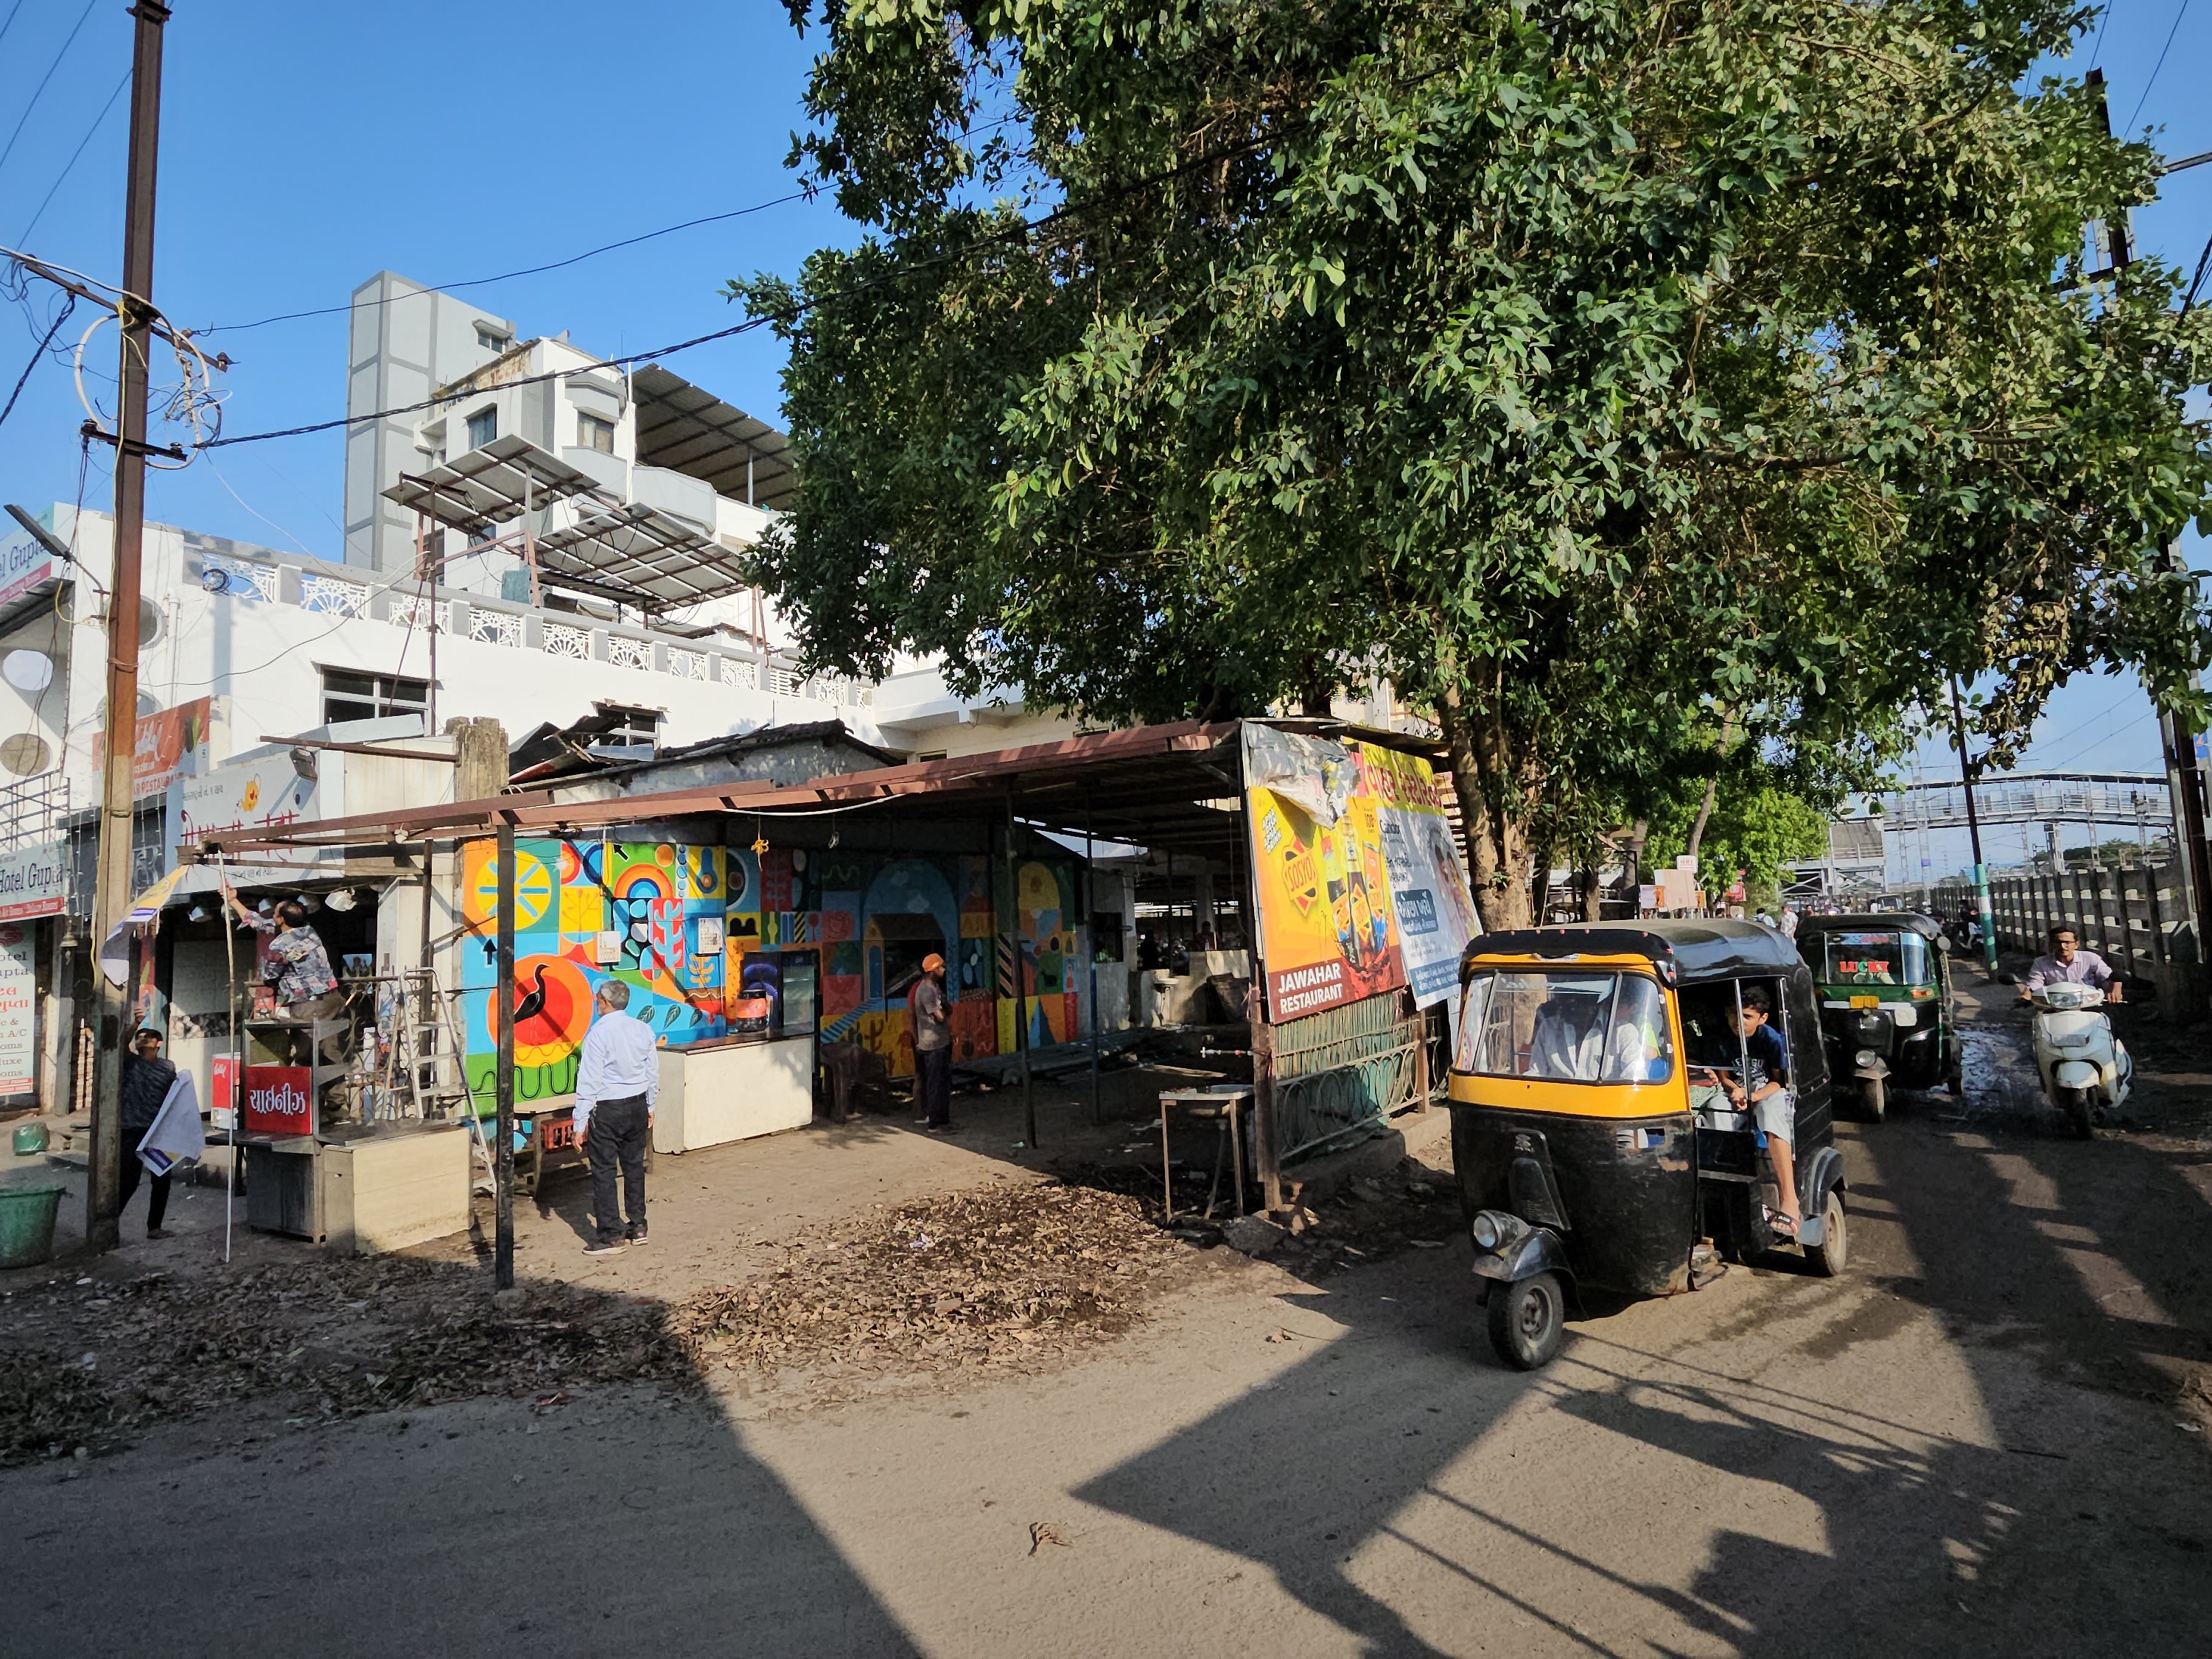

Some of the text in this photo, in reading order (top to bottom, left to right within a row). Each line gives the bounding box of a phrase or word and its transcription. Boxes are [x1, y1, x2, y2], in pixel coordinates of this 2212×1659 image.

[1287, 855, 1312, 892] SOSYO
[0, 950, 29, 961] otel
[0, 967, 29, 979] pta
[1839, 961, 1889, 973] LUCKY
[1278, 962, 1341, 994] JAWAHAR
[1280, 983, 1343, 1014] RESTAURANT
[7, 1028, 27, 1038] A/C
[0, 1058, 22, 1066] luxe
